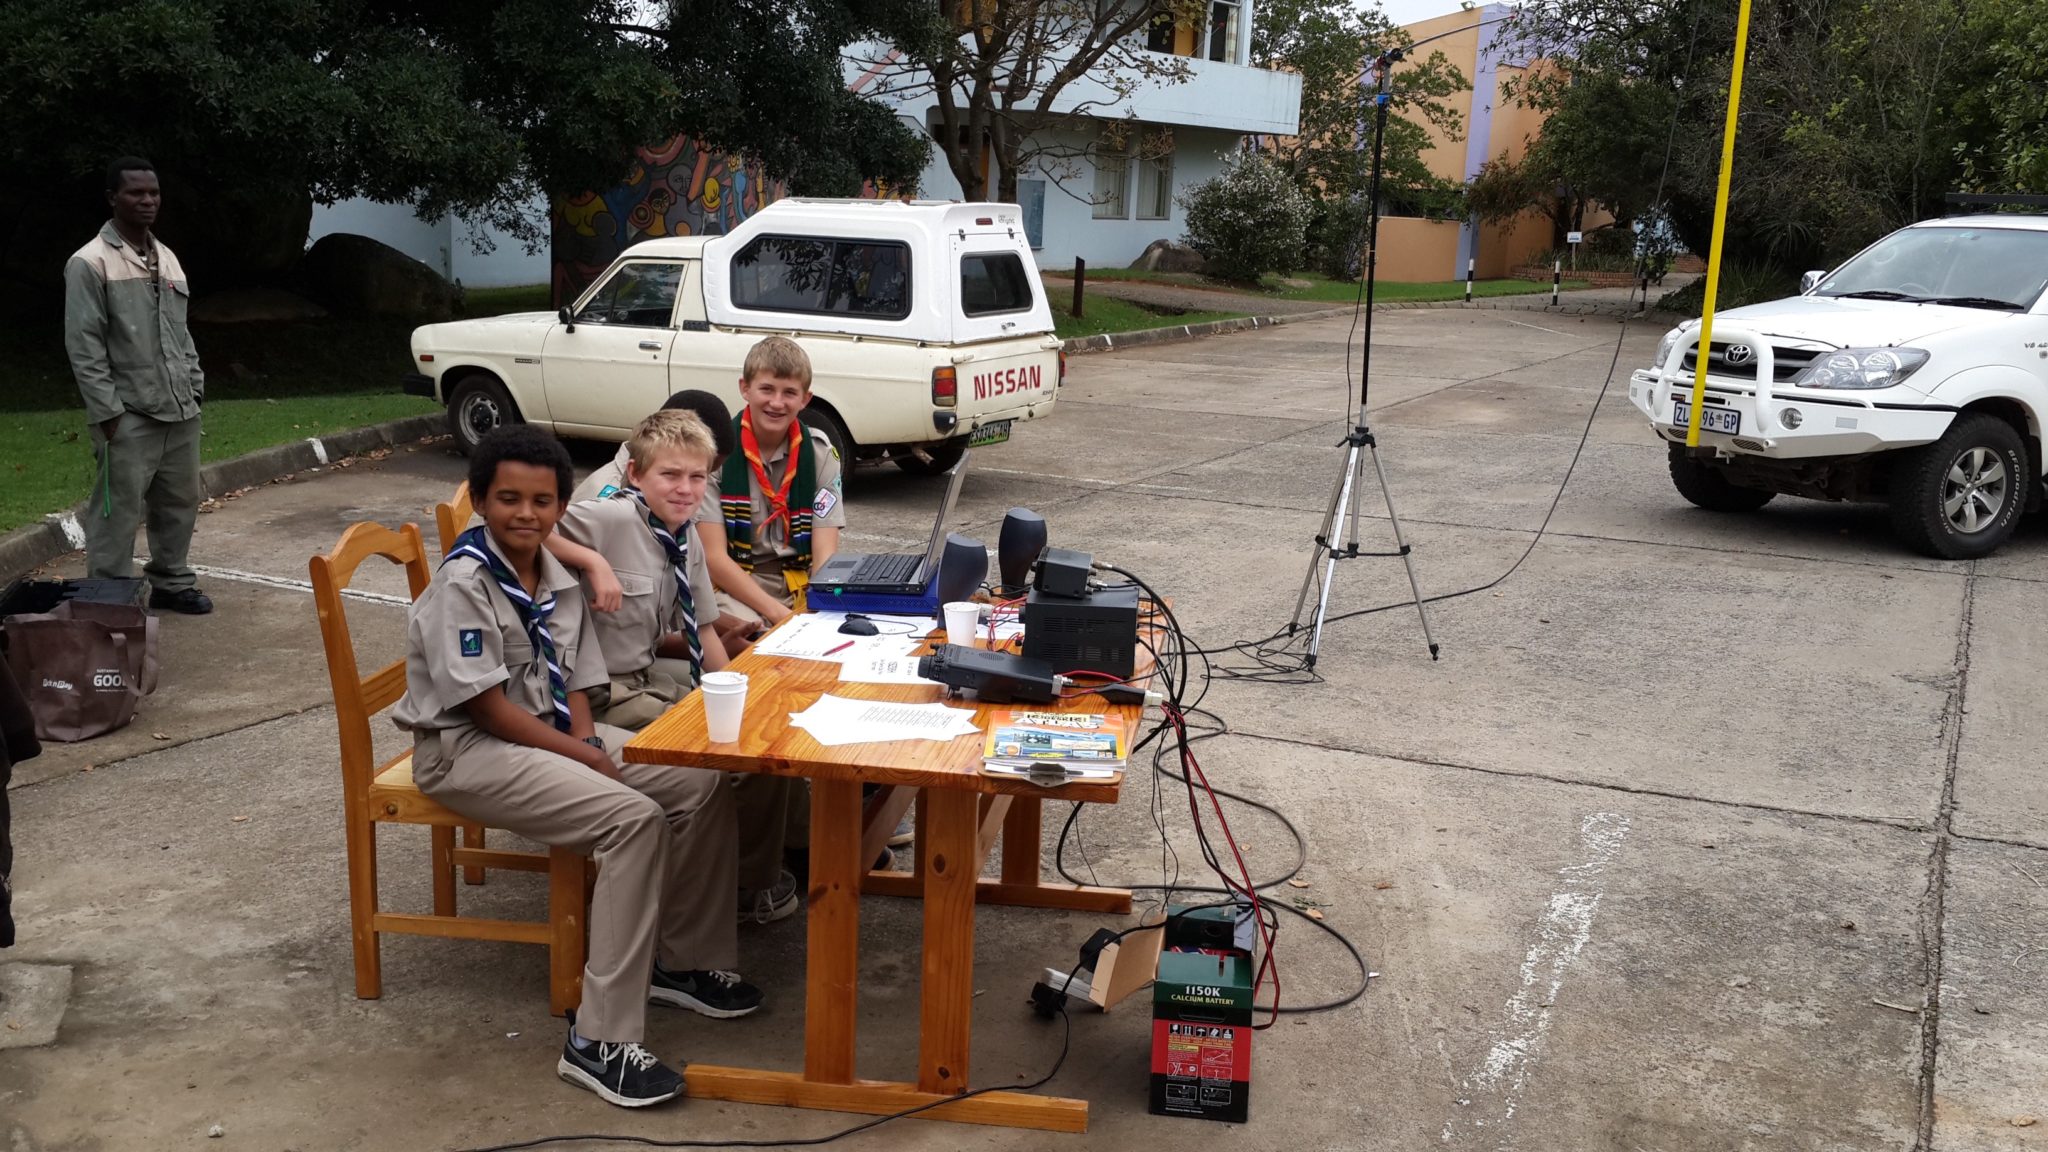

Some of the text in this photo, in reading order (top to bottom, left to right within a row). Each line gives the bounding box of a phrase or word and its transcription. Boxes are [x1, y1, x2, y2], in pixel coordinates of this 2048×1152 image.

[973, 365, 1041, 400] NISSAN
[1723, 413, 1737, 431] GP
[1185, 985, 1221, 997] 1150K
[1171, 994, 1235, 1006] CALCIUM BATTERY
